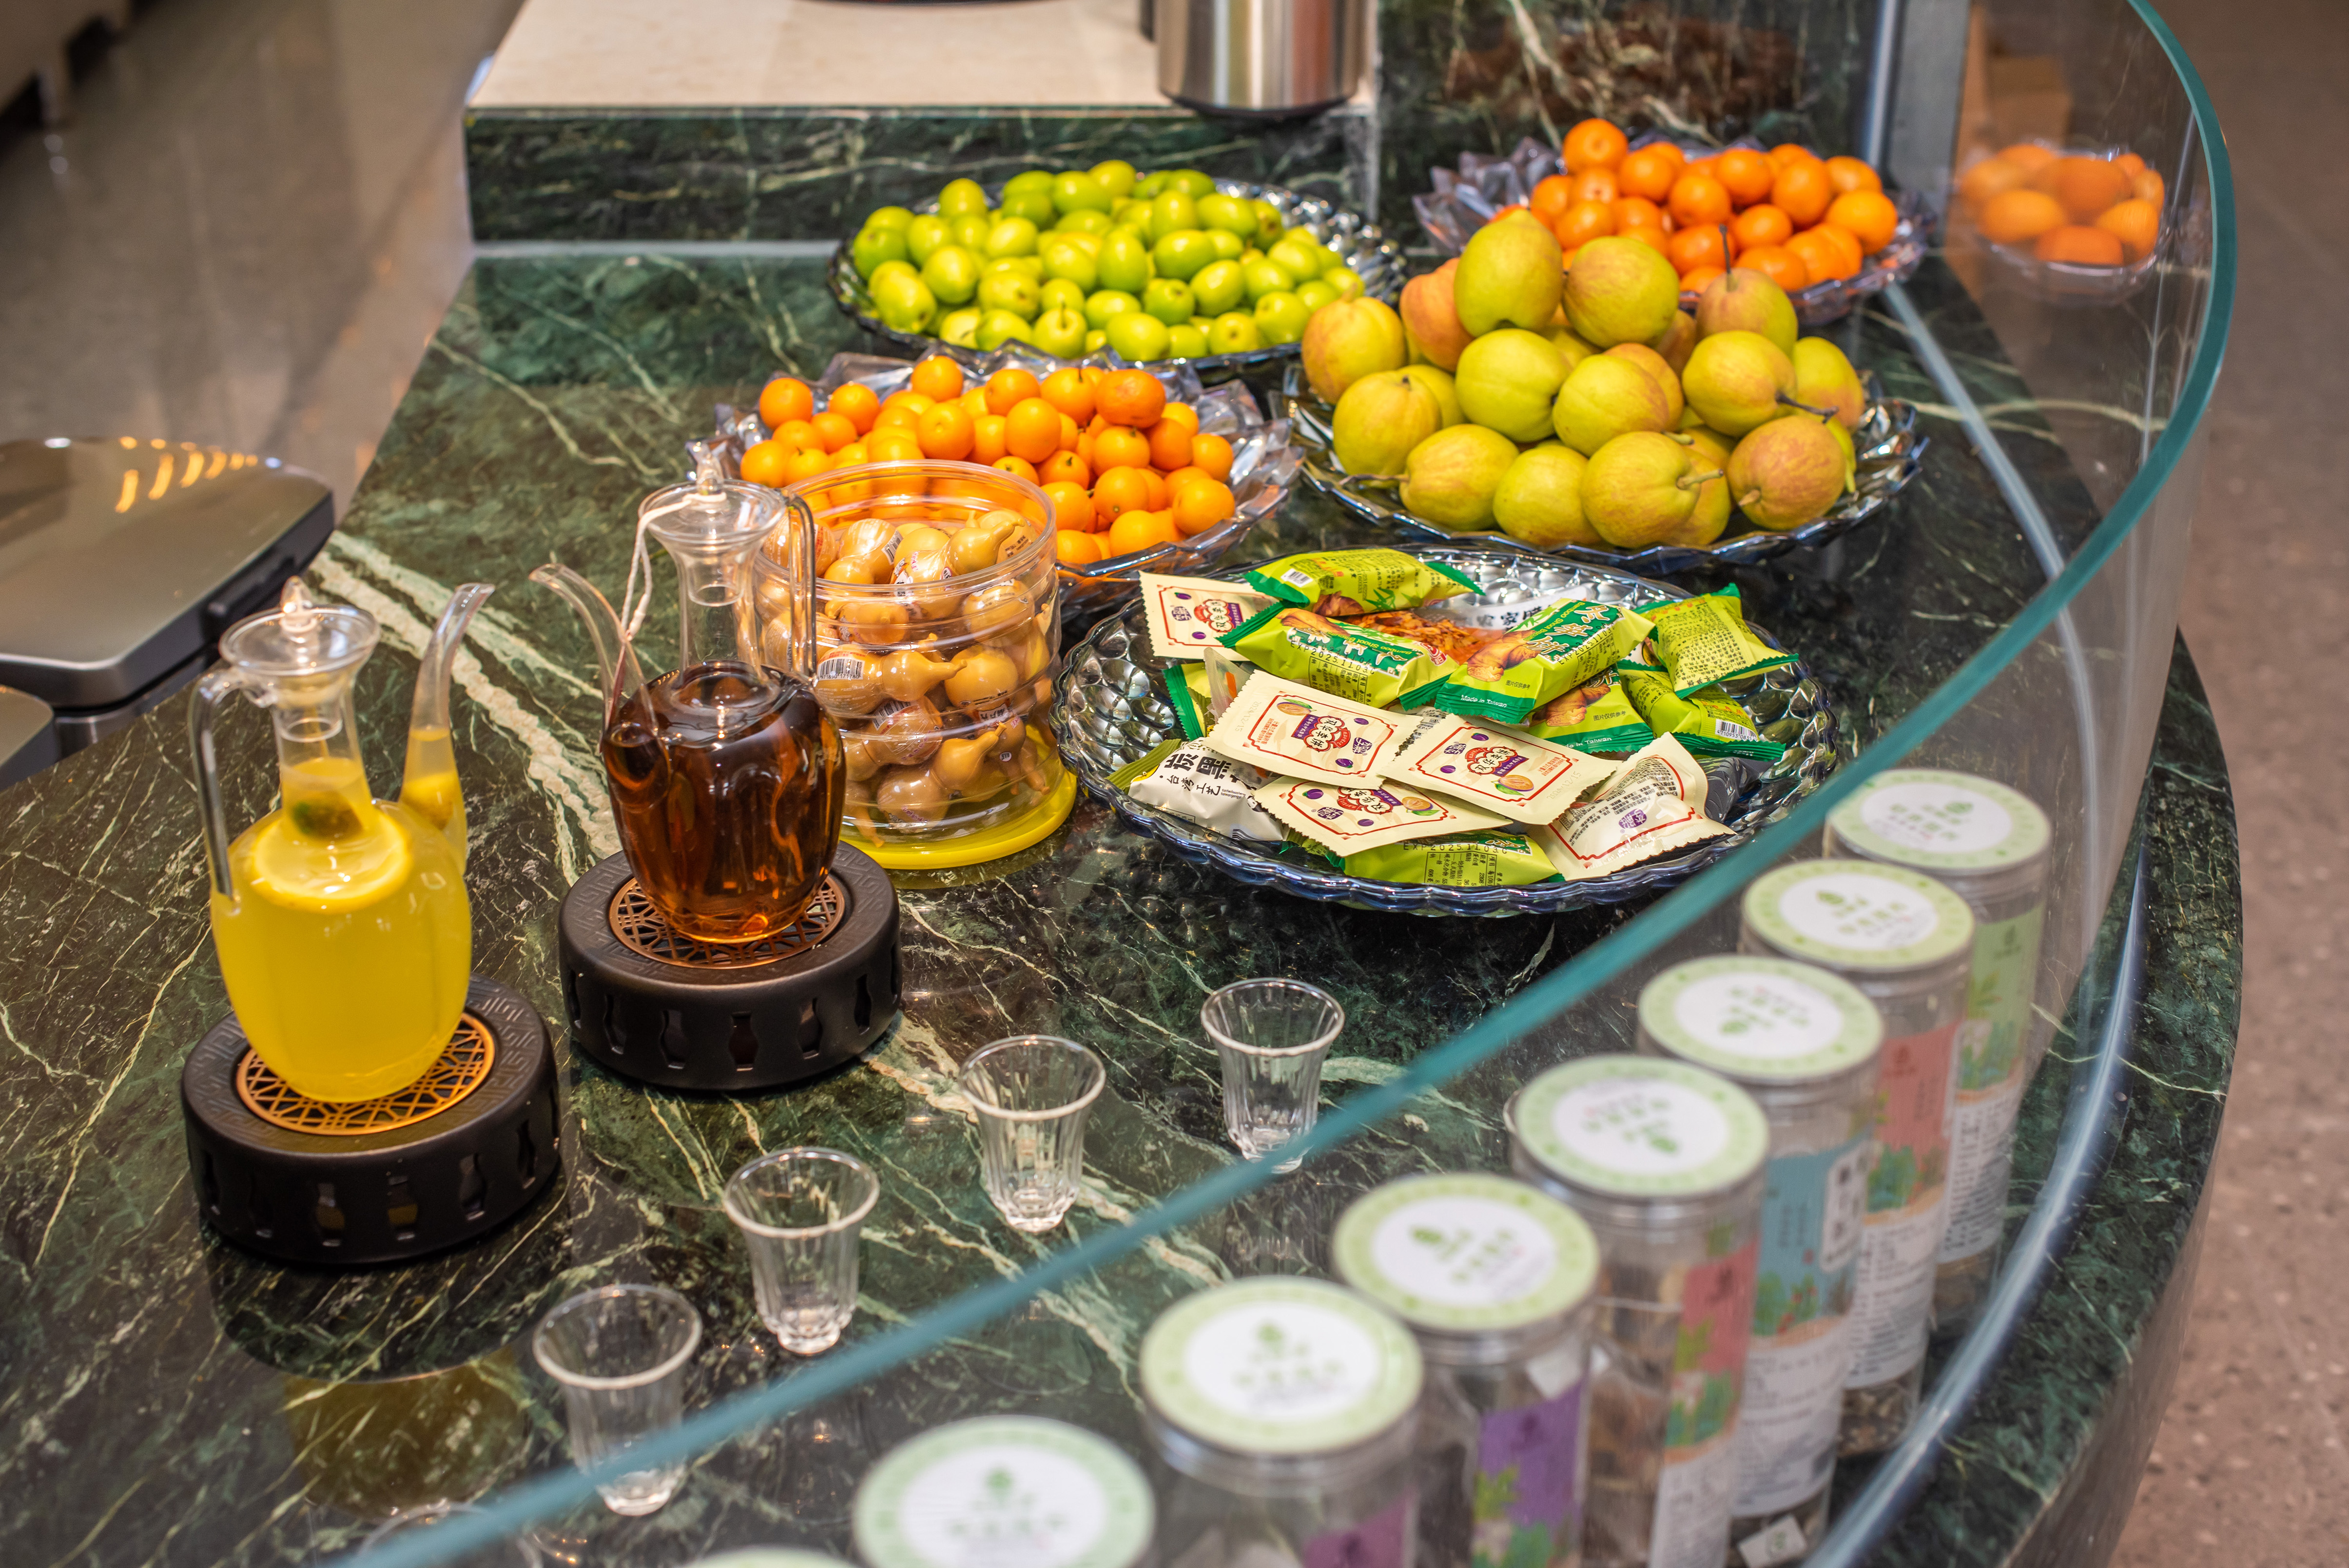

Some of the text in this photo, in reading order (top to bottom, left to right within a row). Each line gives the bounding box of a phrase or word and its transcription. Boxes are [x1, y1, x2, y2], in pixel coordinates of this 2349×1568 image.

[1561, 602, 1585, 618] Bamboo
[1544, 618, 1564, 632] Shoot
[1357, 639, 1379, 649] Shoot
[1380, 646, 1413, 655] Bamboo
[1460, 694, 1478, 702] Made
[1486, 699, 1508, 708] Taiwan
[1593, 711, 1626, 721] 图片仅供参考
[1475, 749, 1512, 772] 双华李饼
